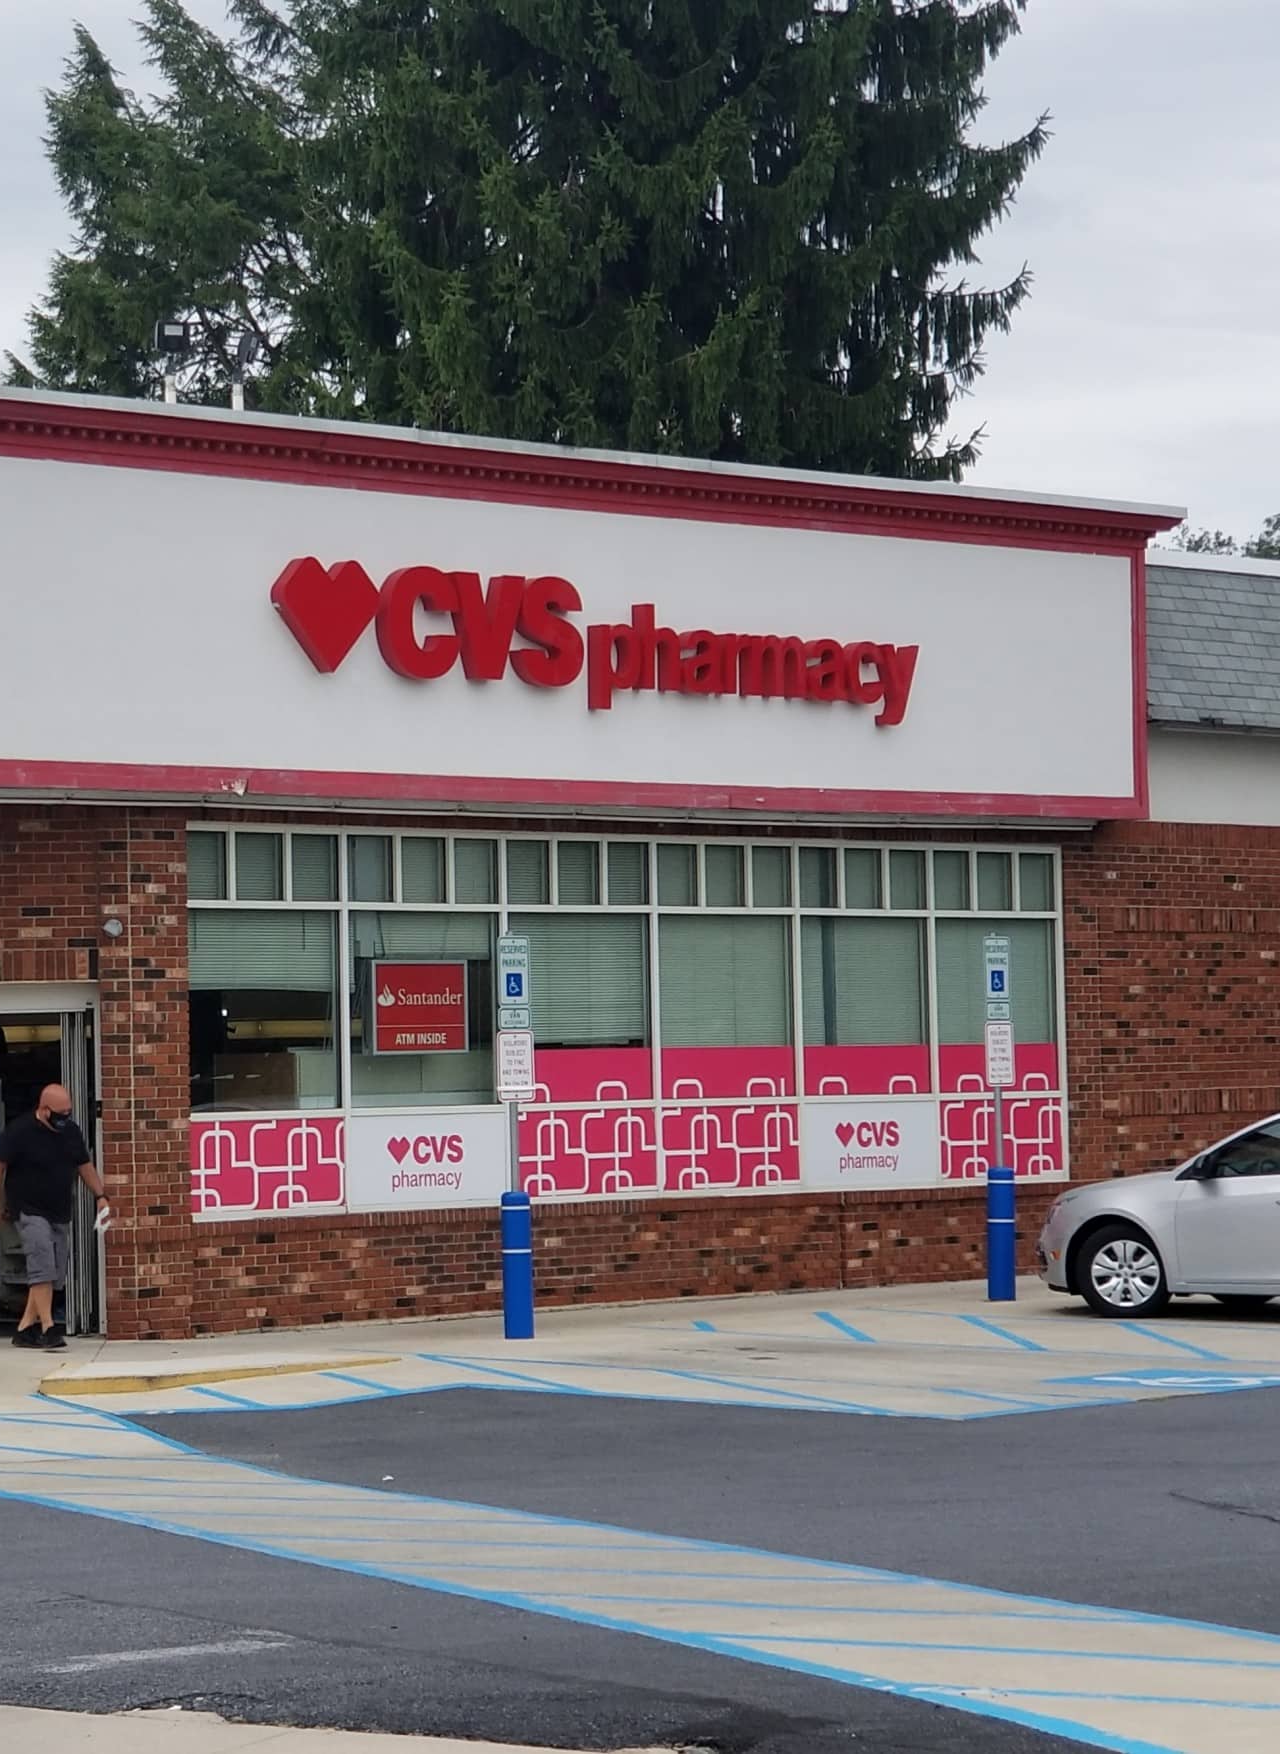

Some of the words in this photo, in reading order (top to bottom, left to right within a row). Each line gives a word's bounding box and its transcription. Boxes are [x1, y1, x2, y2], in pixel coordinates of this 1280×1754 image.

[375, 566, 585, 687] CVS
[587, 603, 919, 726] pharmacy
[398, 987, 463, 1006] Santander
[395, 1033, 415, 1045] ATM
[417, 1032, 447, 1045] INSIDE
[855, 1121, 901, 1148] CVS
[411, 1135, 464, 1165] CVS
[839, 1151, 899, 1172] pharmacy
[391, 1168, 462, 1190] pharmacy
